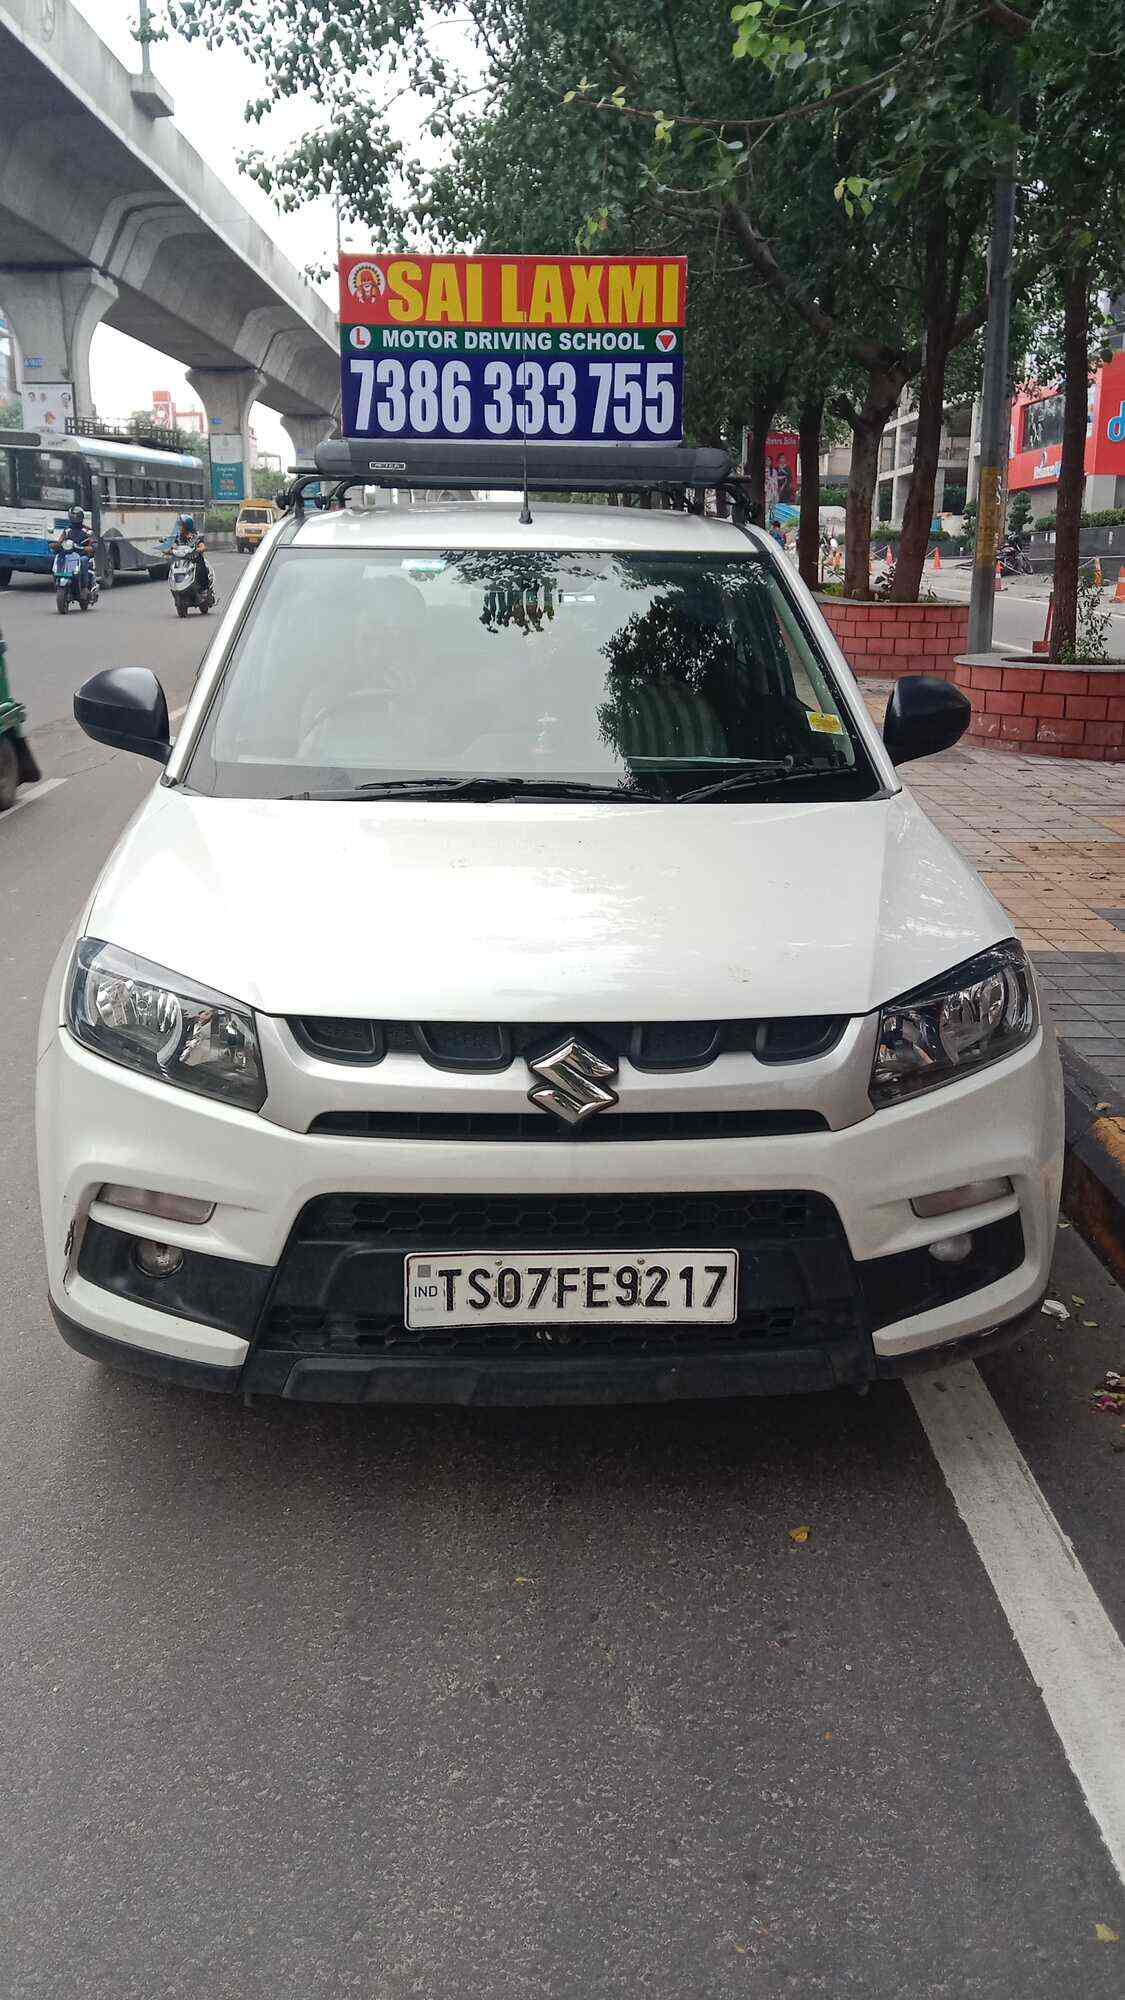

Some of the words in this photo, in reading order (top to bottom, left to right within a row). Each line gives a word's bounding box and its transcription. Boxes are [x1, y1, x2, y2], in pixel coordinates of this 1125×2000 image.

[387, 261, 483, 323] SAI
[501, 264, 679, 323] LAXMI
[355, 327, 366, 346] L
[382, 330, 458, 350] MOTOR
[464, 331, 552, 351] DRIVING
[559, 332, 644, 351] SCHOOL
[350, 359, 472, 433] 7386
[483, 361, 577, 435] 333
[589, 362, 675, 435] 755
[414, 1285, 438, 1298] IND
[438, 1265, 728, 1311] TS07FE9217
